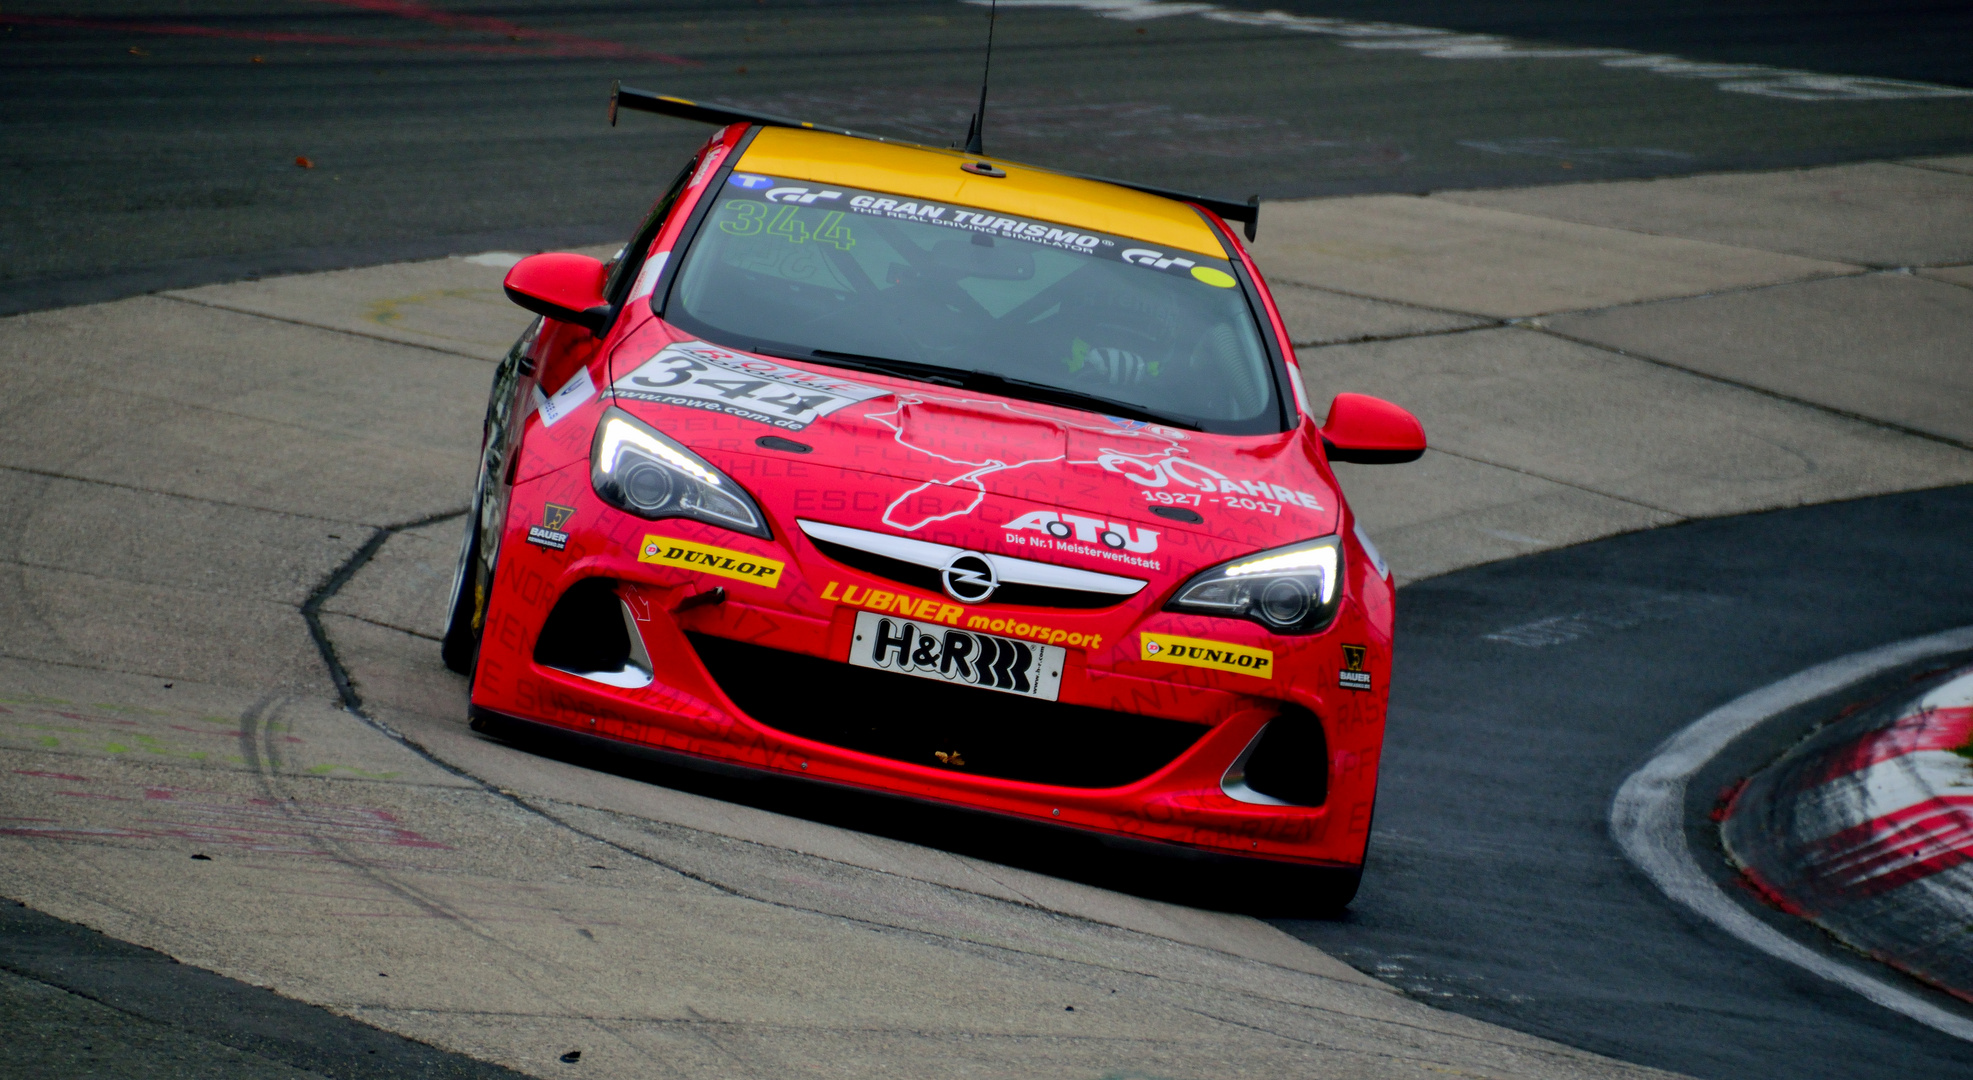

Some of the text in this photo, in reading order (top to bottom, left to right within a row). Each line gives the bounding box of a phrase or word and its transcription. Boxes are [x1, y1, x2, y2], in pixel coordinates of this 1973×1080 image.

[719, 199, 857, 251] 344
[849, 194, 946, 223] GRAN
[851, 206, 1094, 255] THE REAL DRIVING SIMULATOR
[631, 356, 836, 417] 344
[600, 387, 804, 432] www.rowe.com.de
[1141, 490, 1202, 507] 1927
[1222, 496, 1283, 517] 2017
[1199, 478, 1325, 512] JAHRE
[529, 526, 568, 543] BAUER
[1005, 533, 1026, 546] Die
[1056, 541, 1161, 571] Meisterwerkstatt
[663, 546, 777, 579] DUNLOP
[819, 581, 965, 626] LUBNER
[966, 614, 1103, 649] motorsport
[872, 617, 990, 688] H&R
[1167, 643, 1270, 671] DUNLOP
[1340, 671, 1371, 683] BAUER
